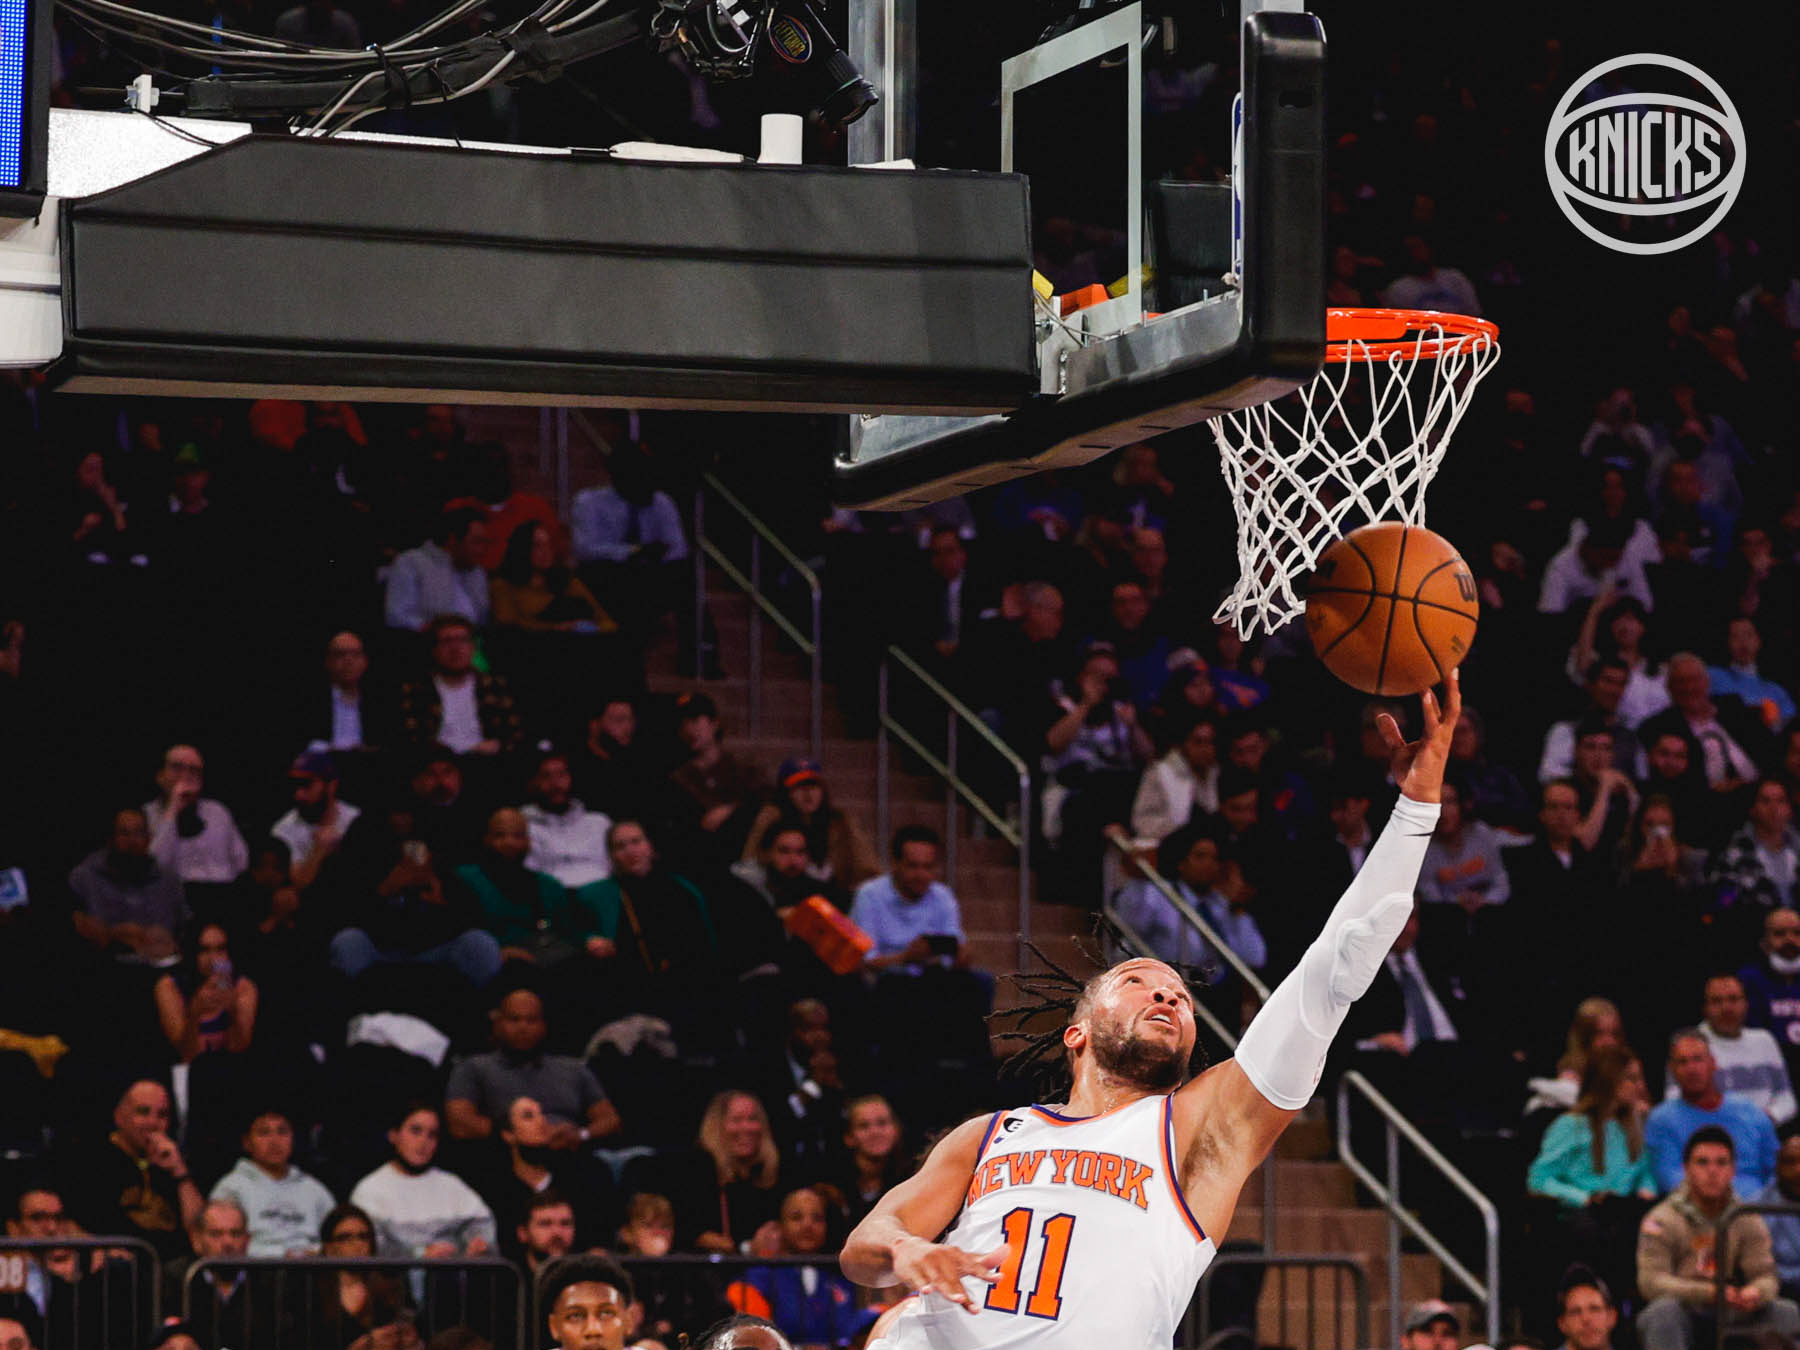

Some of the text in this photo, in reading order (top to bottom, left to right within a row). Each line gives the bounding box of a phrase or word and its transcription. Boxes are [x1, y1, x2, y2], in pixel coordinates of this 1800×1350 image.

[967, 1149, 1154, 1211] NEW YORK
[984, 1206, 1077, 1321] 11
